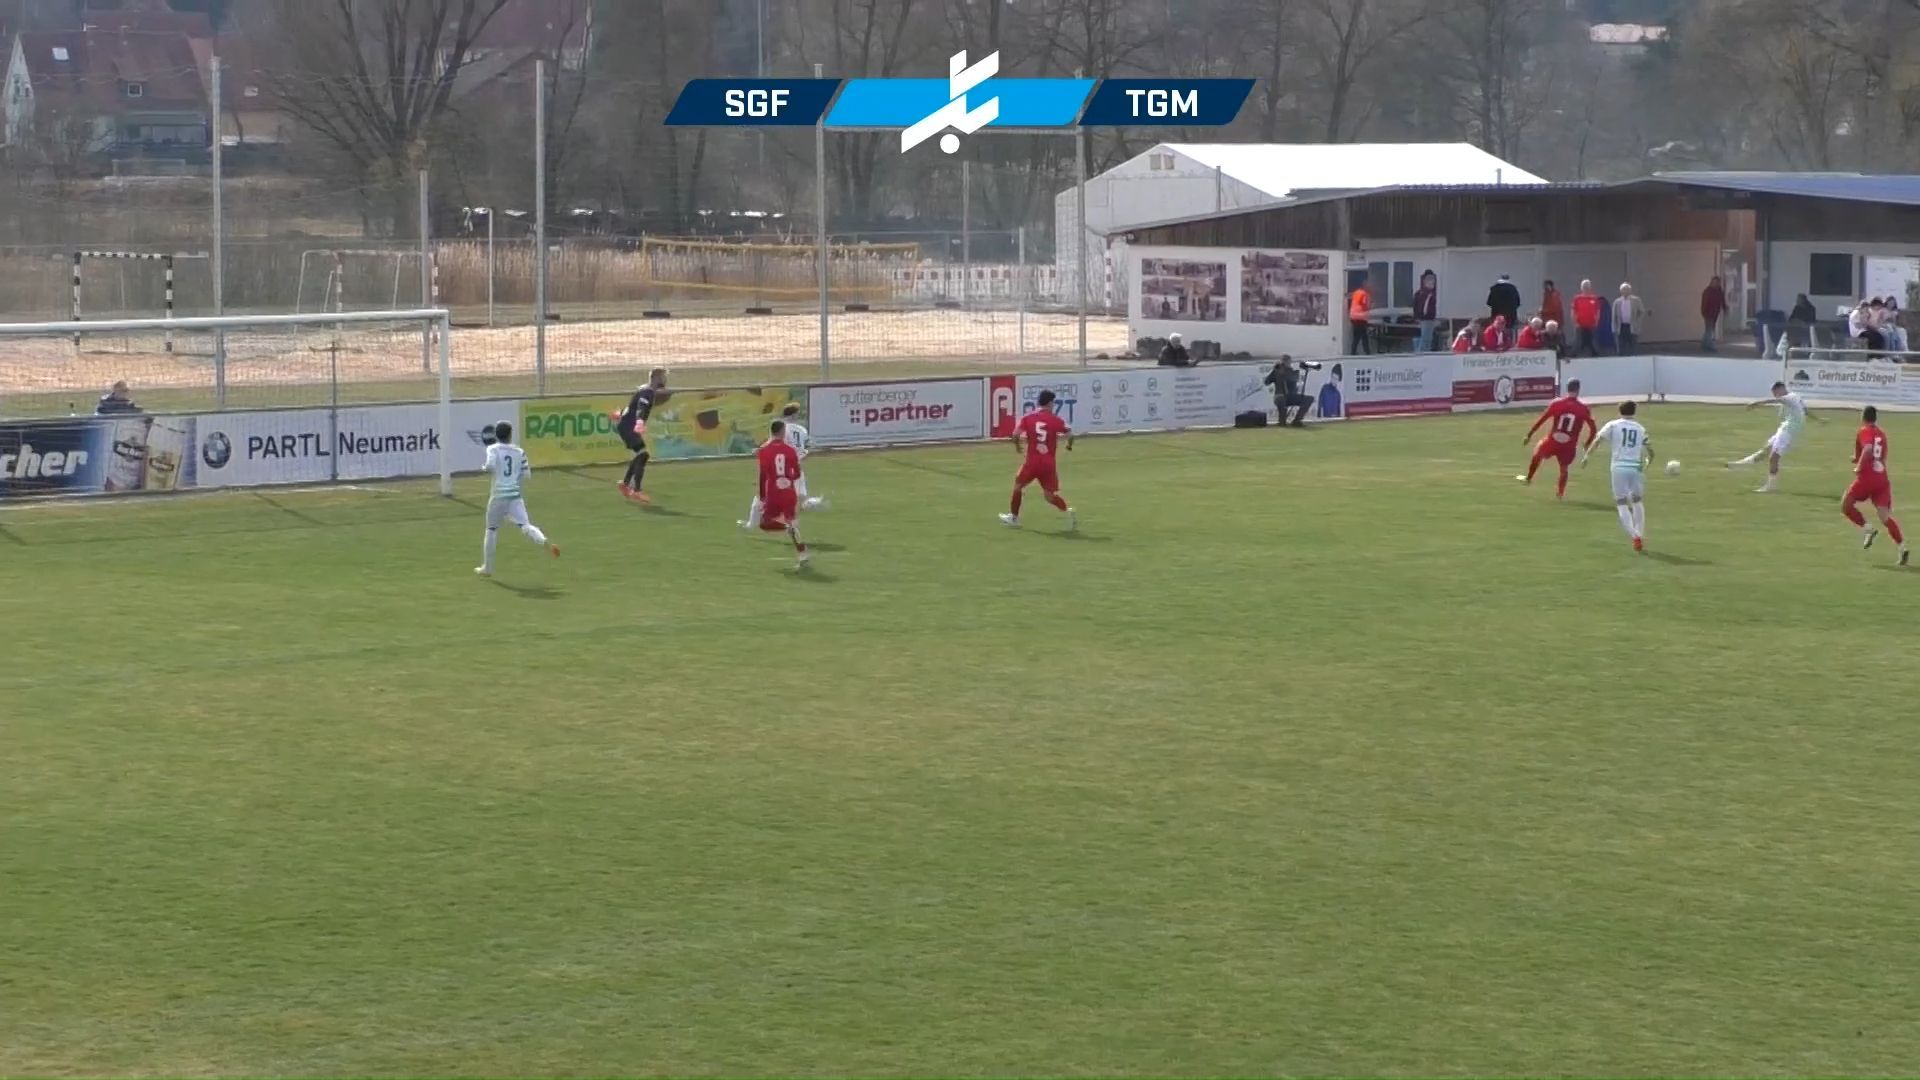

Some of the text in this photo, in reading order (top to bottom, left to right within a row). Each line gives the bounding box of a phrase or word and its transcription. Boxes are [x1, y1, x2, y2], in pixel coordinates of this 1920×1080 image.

[1818, 369, 1897, 385] Gerhard Striegel
[865, 403, 953, 427] partner
[1035, 421, 1047, 441] 5
[1621, 427, 1637, 448] 19
[248, 428, 440, 460] PARTL Neumark
[1873, 437, 1882, 458] 6
[0, 443, 88, 479] cher
[504, 455, 512, 477] 3
